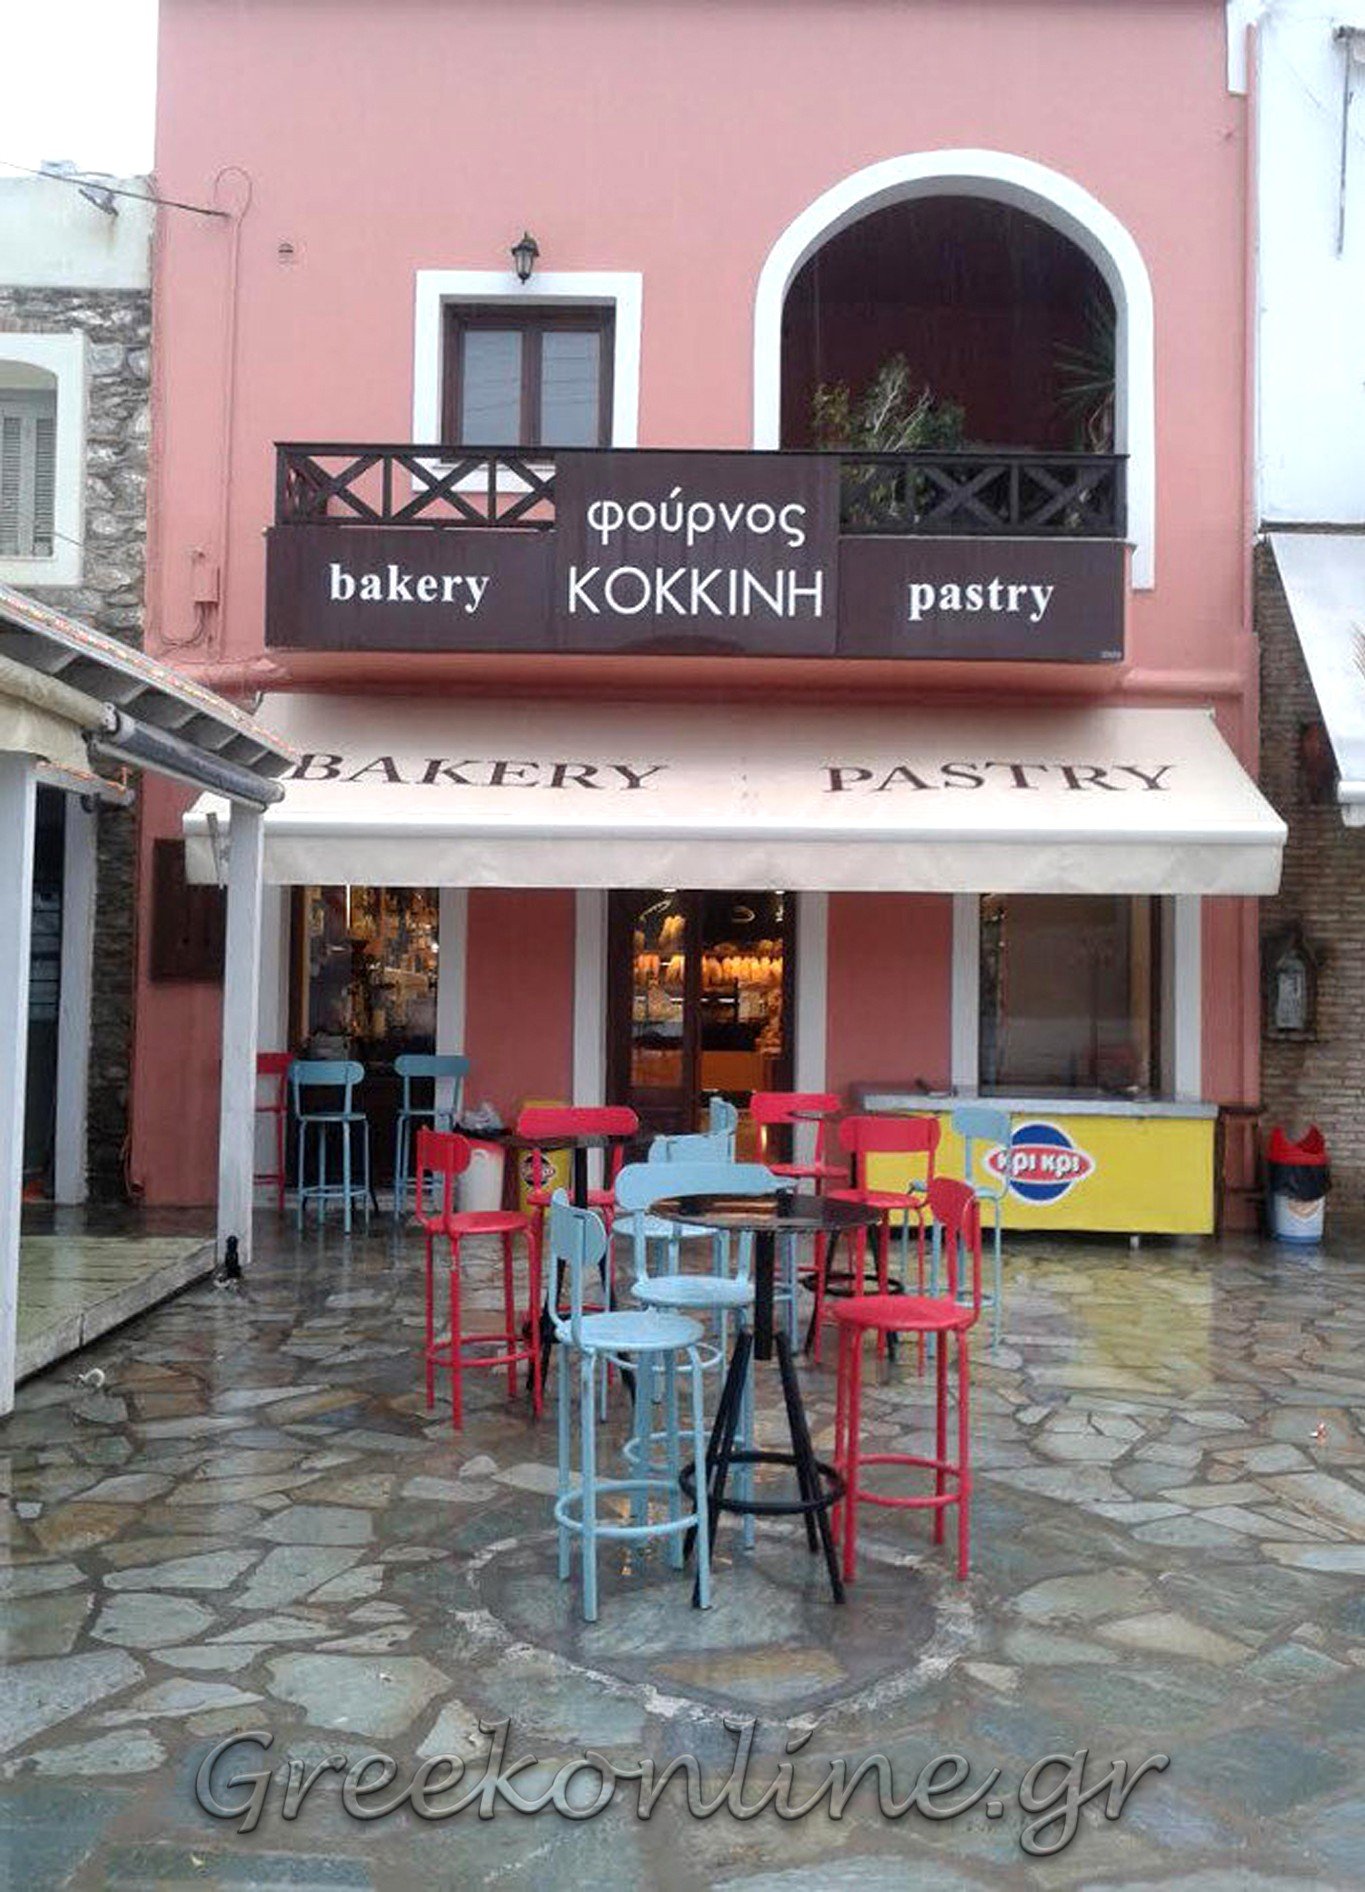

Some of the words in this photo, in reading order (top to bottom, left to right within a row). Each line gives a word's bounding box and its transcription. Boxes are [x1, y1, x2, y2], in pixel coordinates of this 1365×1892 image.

[585, 485, 808, 549] φούρνος
[328, 562, 490, 615] bakery
[566, 564, 825, 619] ΚΟΚΚΙΝΗ
[907, 575, 1055, 623] pastry
[285, 753, 672, 791] BAKERY
[821, 761, 1178, 794] PASTRY
